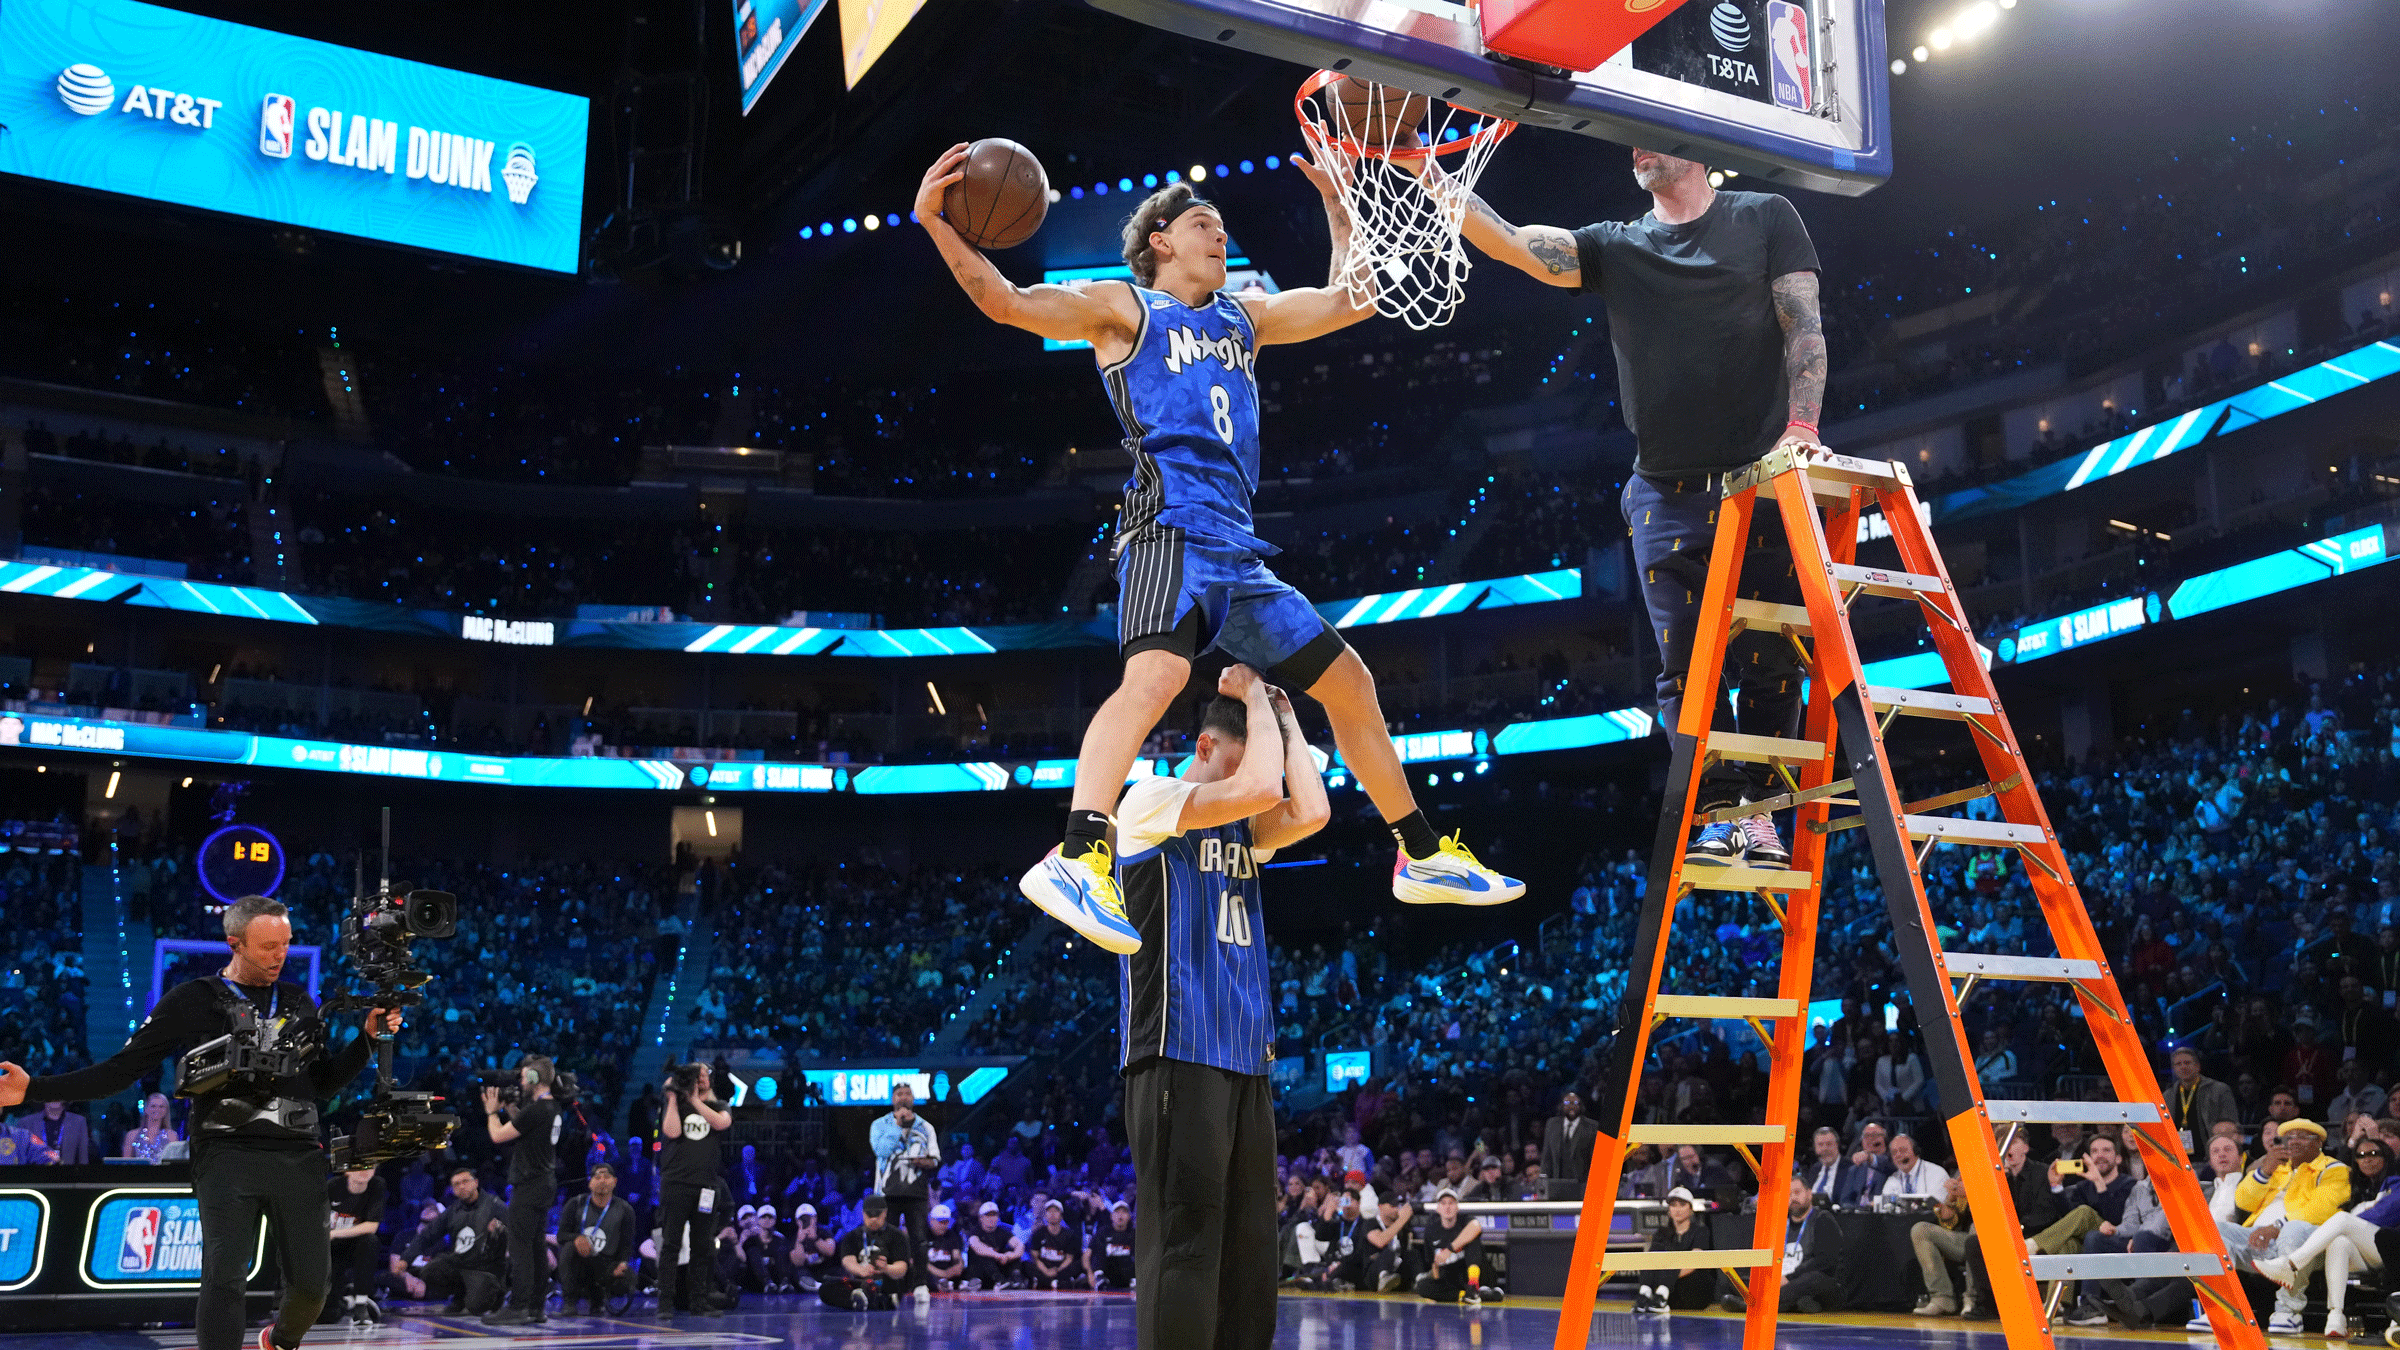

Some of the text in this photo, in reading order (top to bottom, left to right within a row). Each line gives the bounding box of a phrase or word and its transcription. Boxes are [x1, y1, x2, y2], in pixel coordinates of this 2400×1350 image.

[121, 84, 222, 129] AT&T
[1777, 82, 1798, 103] NBA
[304, 106, 496, 193] SLAM DUNK
[1210, 385, 1234, 445] 8
[462, 615, 494, 642] MAC
[2073, 607, 2109, 642] SLAM
[2108, 597, 2146, 632] DUNK
[30, 721, 62, 746] MAC
[352, 745, 391, 774] SLAM
[766, 766, 800, 789] SLAM
[849, 1073, 890, 1101] SLAM
